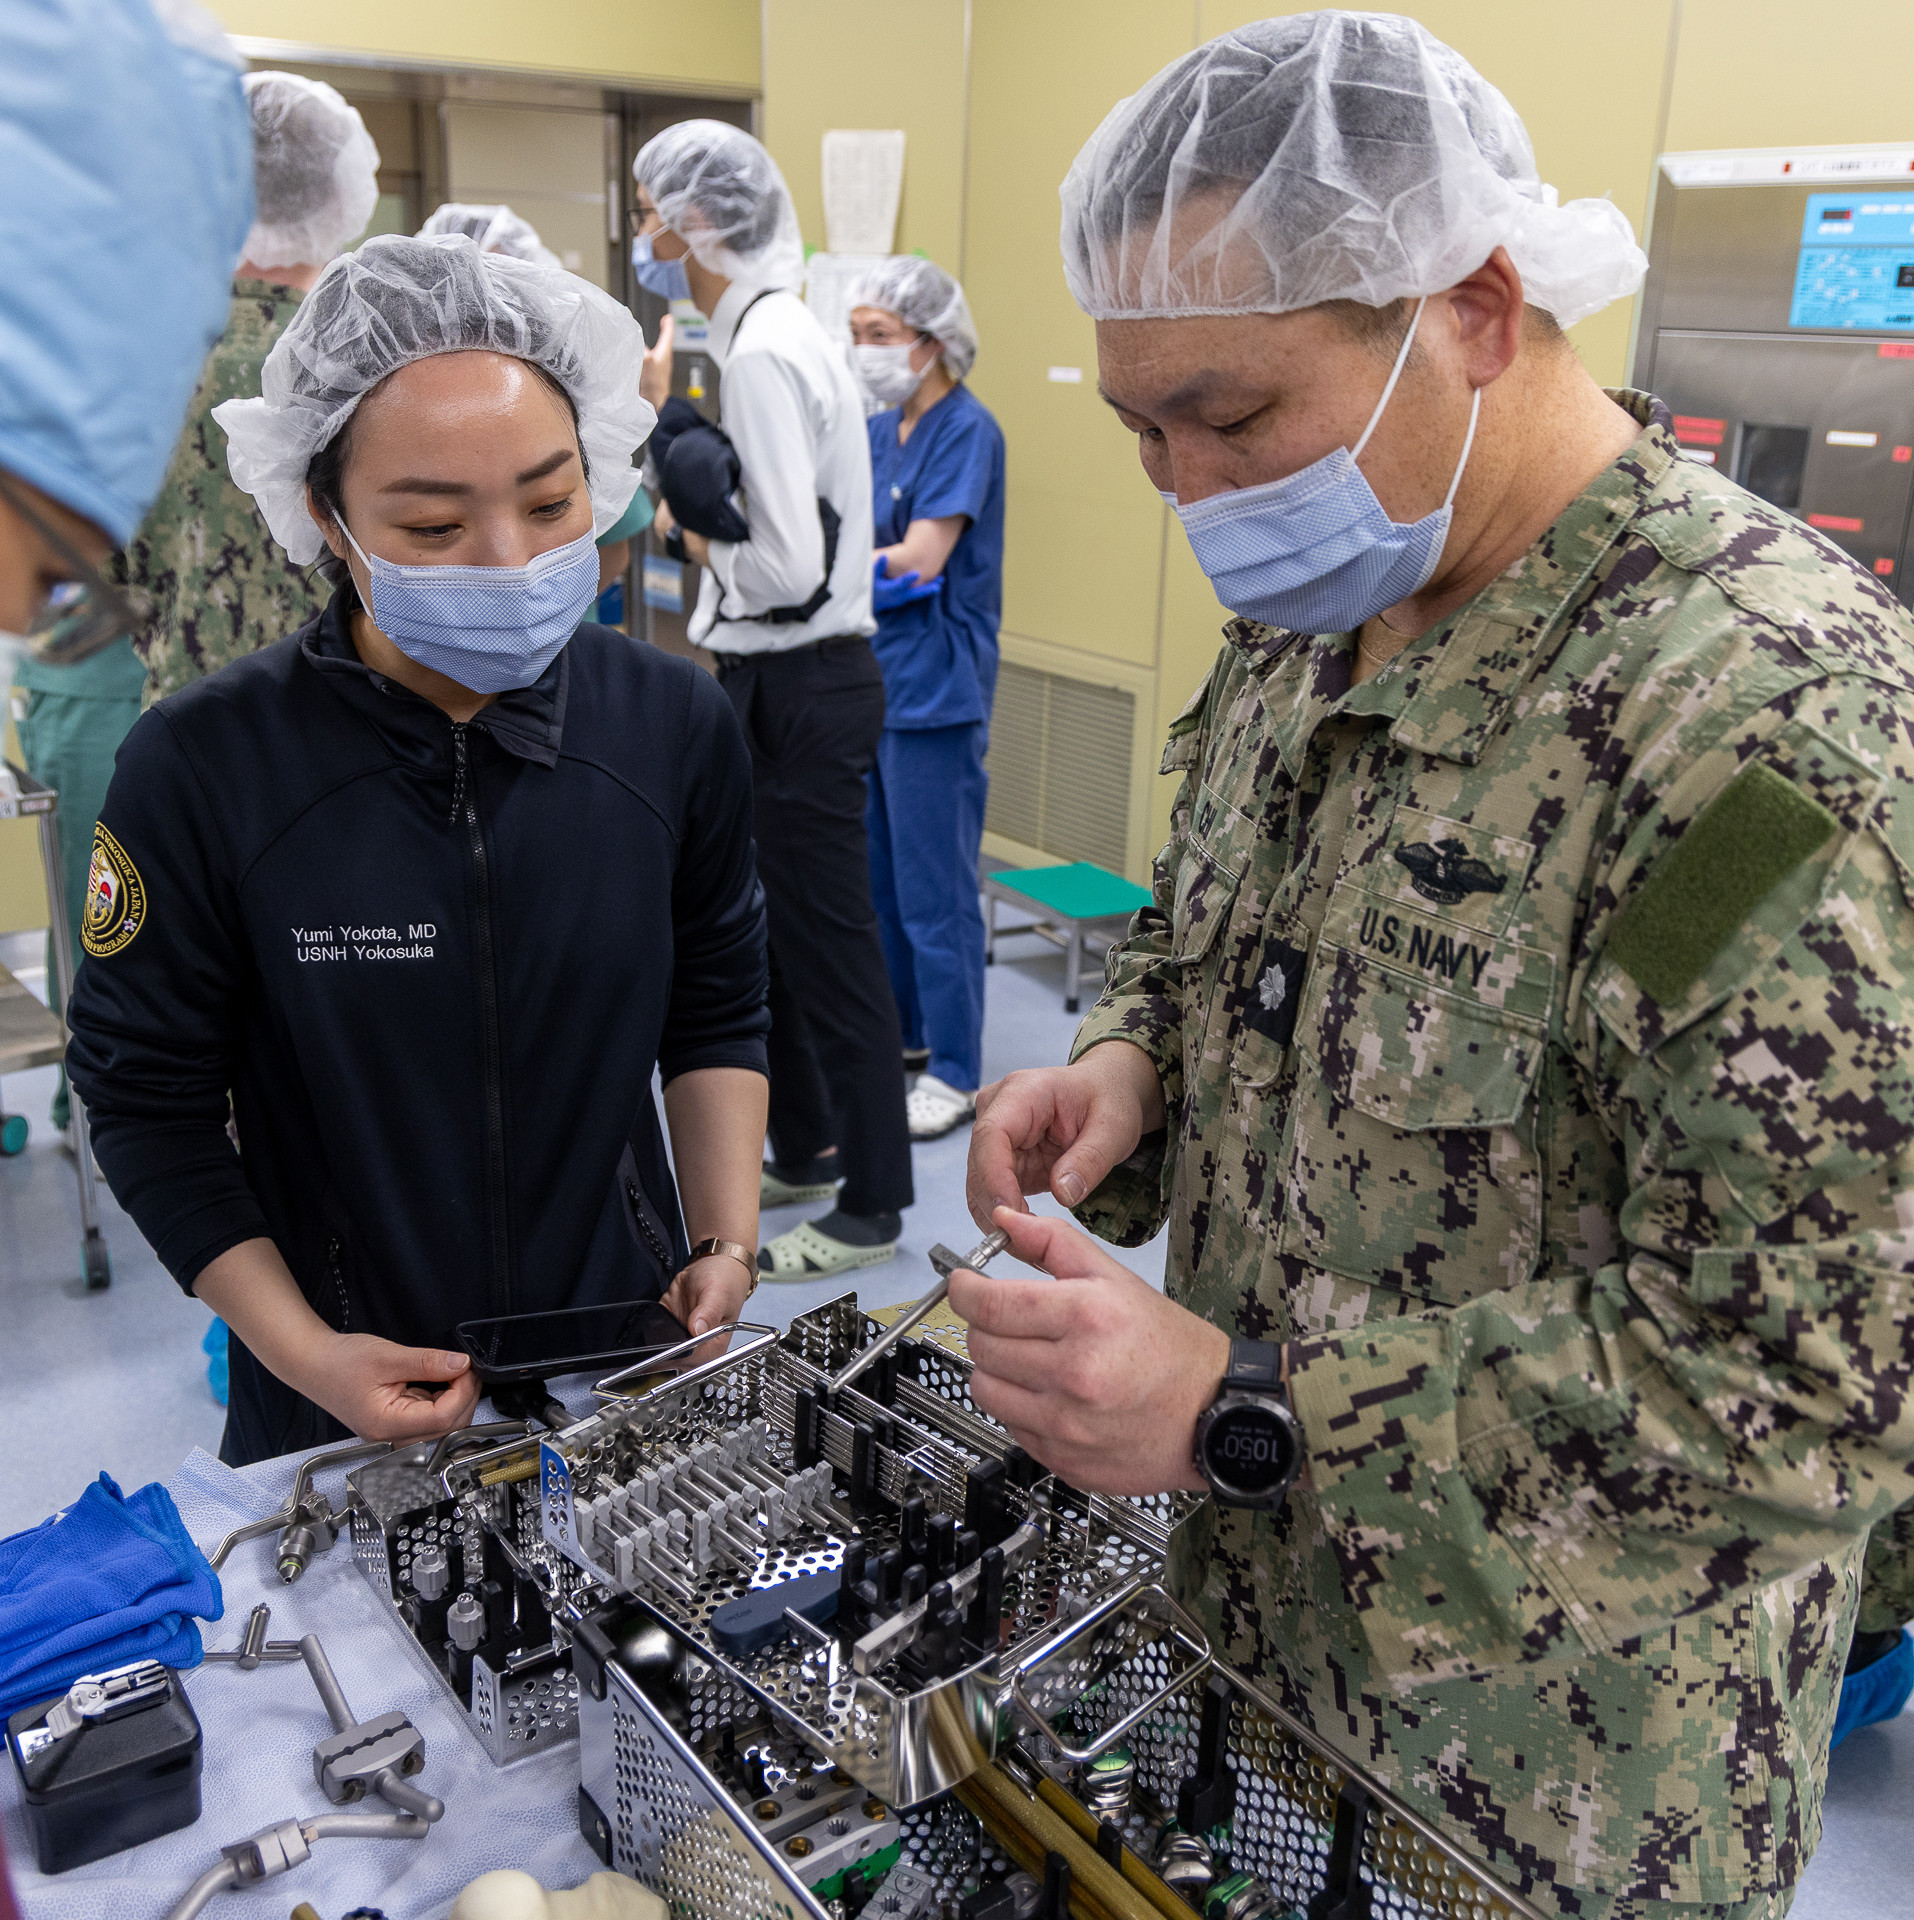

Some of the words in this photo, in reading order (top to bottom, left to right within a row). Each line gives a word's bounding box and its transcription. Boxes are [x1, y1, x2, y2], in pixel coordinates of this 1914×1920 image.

[103, 834, 136, 885] YOKOSUKA
[129, 885, 143, 920] JAPAN
[291, 926, 334, 943] Yumi
[339, 925, 403, 942] Yokota,
[408, 923, 437, 940] MD
[1359, 906, 1401, 959] U.S.
[1406, 924, 1492, 987] NAVY
[297, 946, 347, 962] USNH
[353, 943, 434, 960] Yokosuka
[1224, 1435, 1279, 1464] 1050
